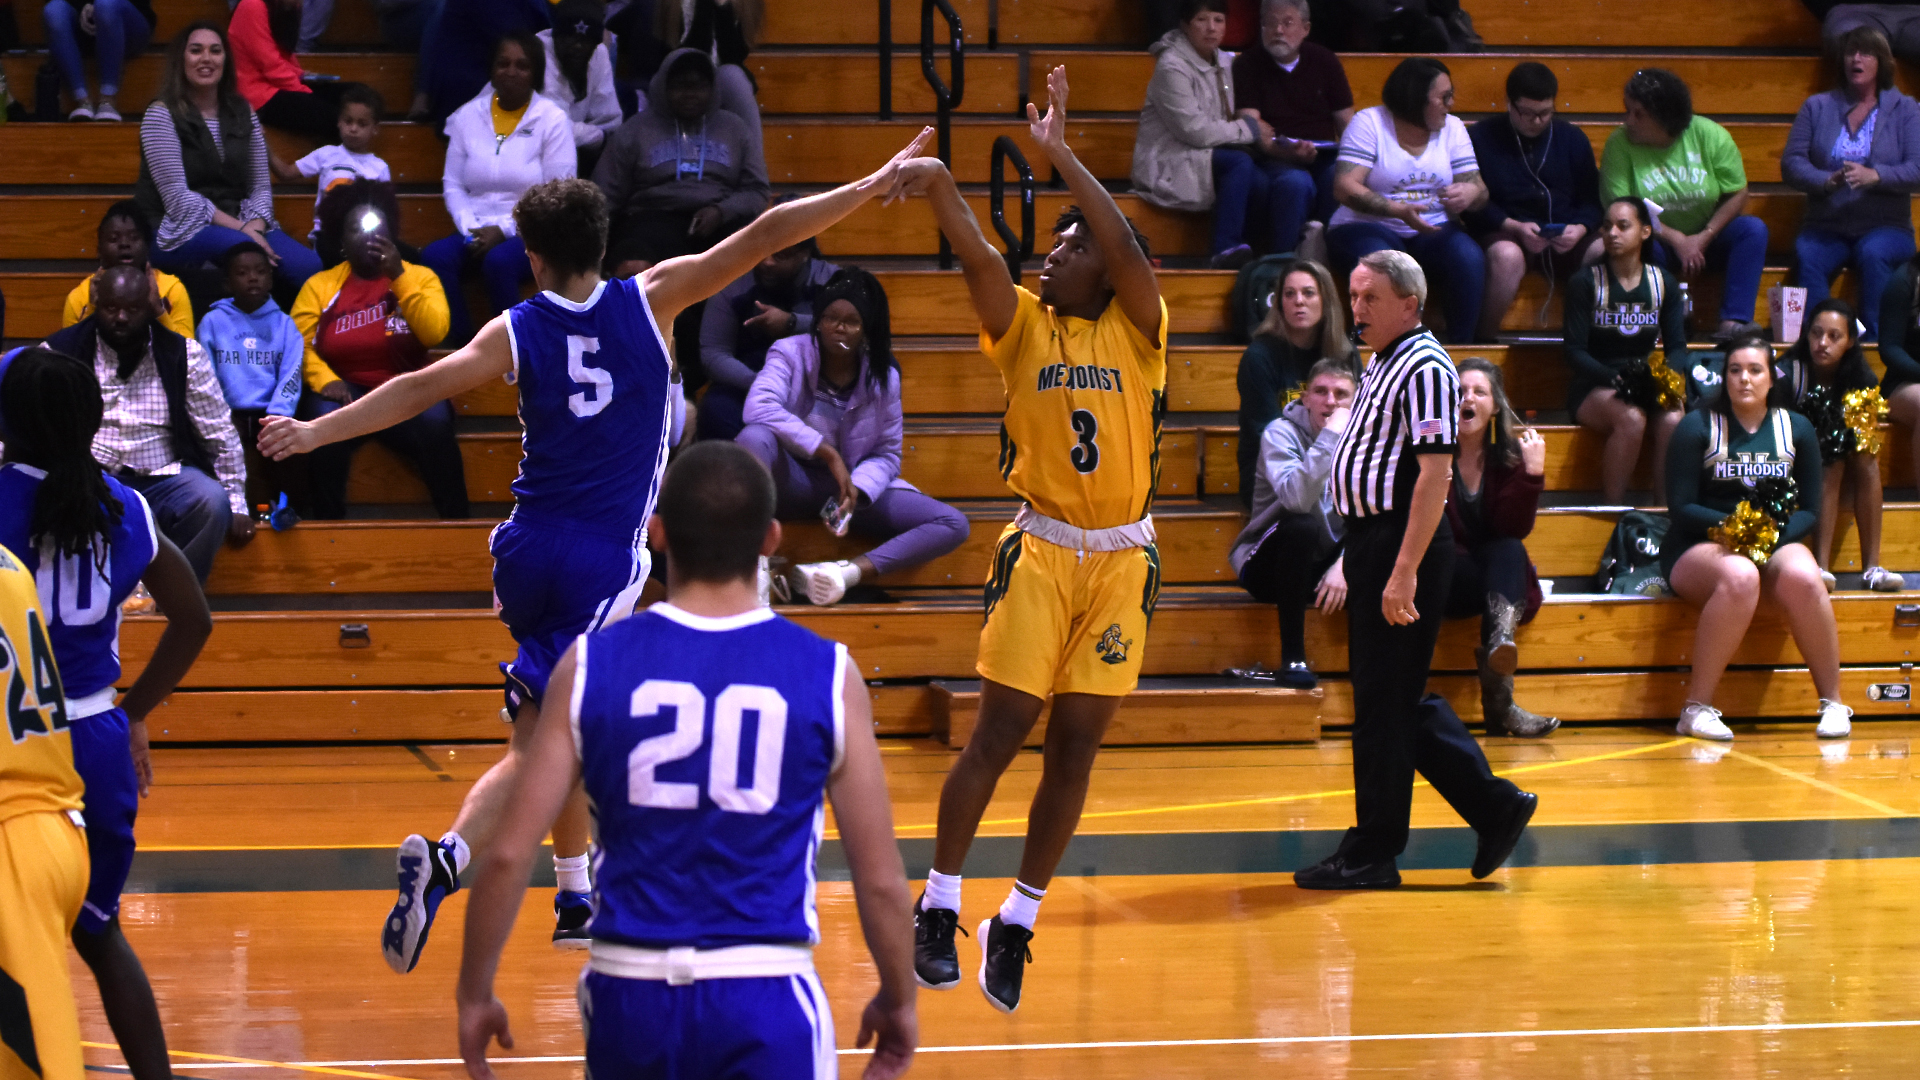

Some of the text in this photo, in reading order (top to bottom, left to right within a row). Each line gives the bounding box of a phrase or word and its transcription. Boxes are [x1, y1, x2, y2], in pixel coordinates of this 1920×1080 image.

[1594, 309, 1659, 326] METHODIST
[217, 350, 241, 365] TAR
[567, 335, 614, 418] 5
[1070, 408, 1100, 475] 3
[1715, 461, 1790, 478] METHODIST
[1634, 576, 1669, 592] METHOD
[0, 607, 71, 745] 24
[627, 678, 789, 816] 20
